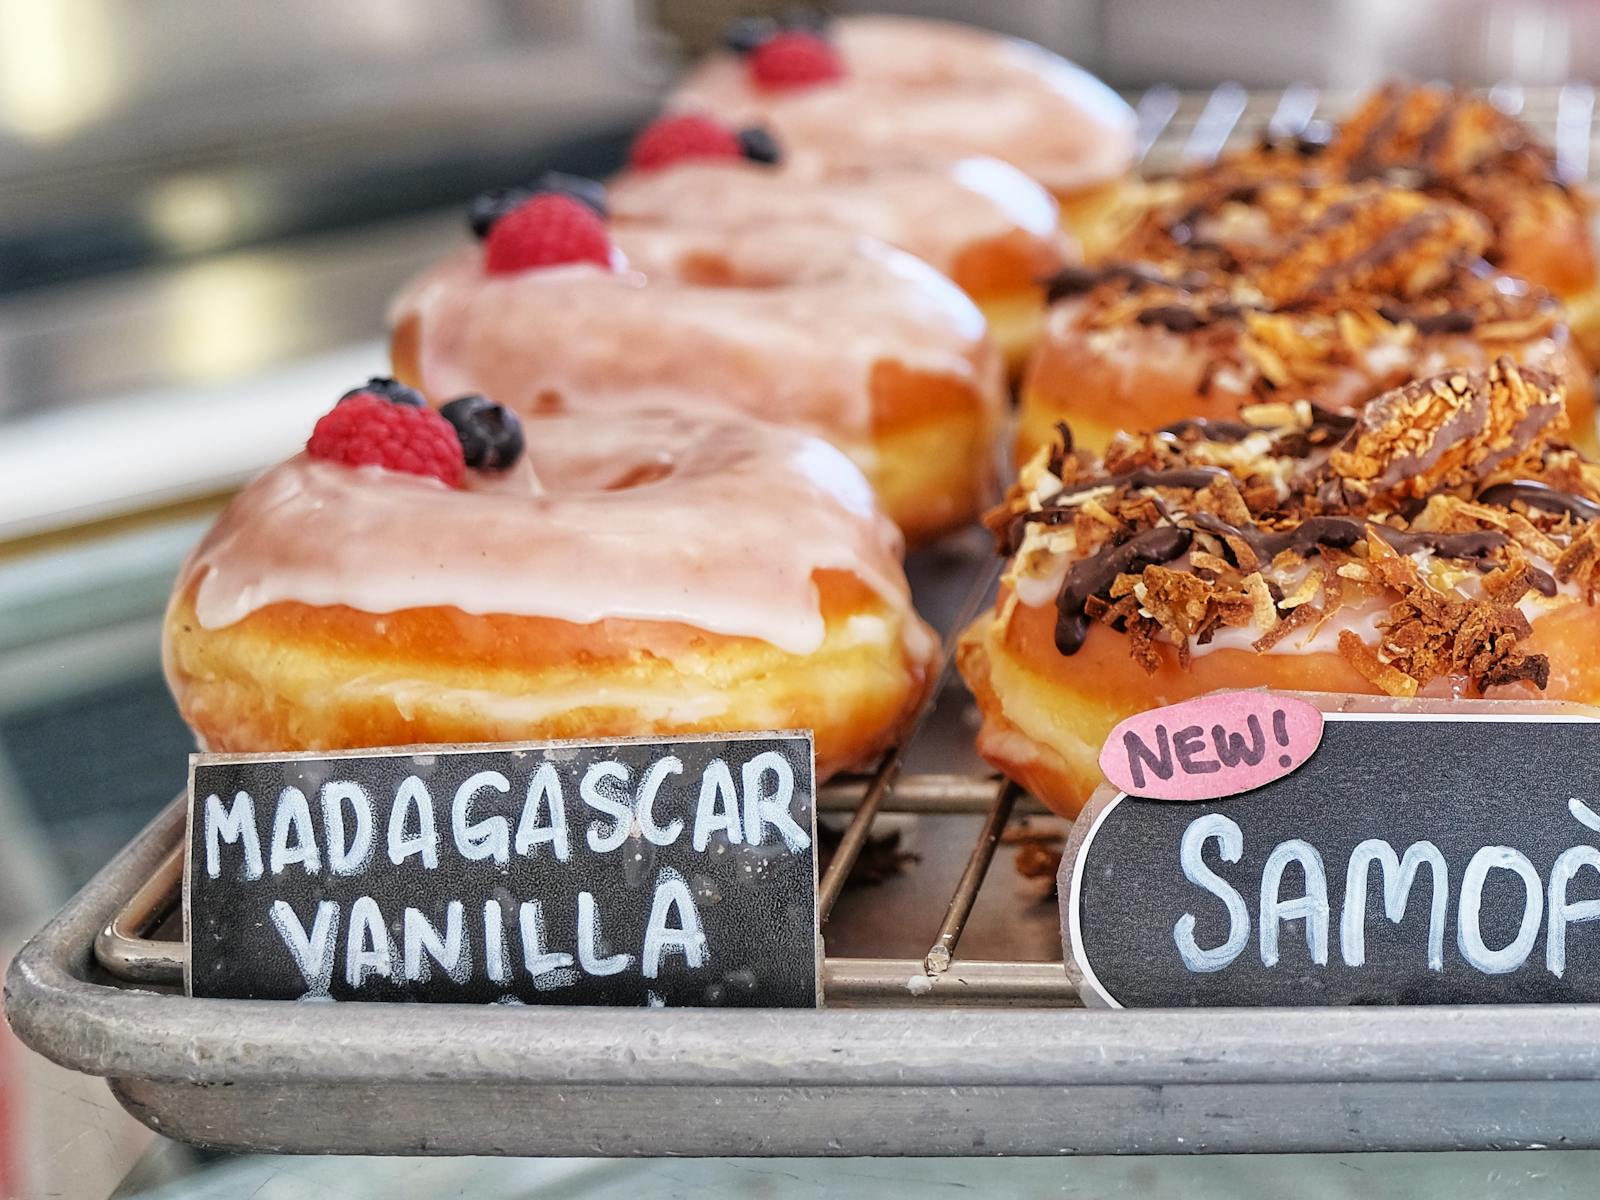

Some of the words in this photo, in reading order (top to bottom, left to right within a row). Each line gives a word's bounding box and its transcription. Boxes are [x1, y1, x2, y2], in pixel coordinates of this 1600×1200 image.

[1124, 709, 1292, 787] NEW!
[206, 752, 808, 879] MADAGASCAR
[269, 868, 710, 996] VANILLA
